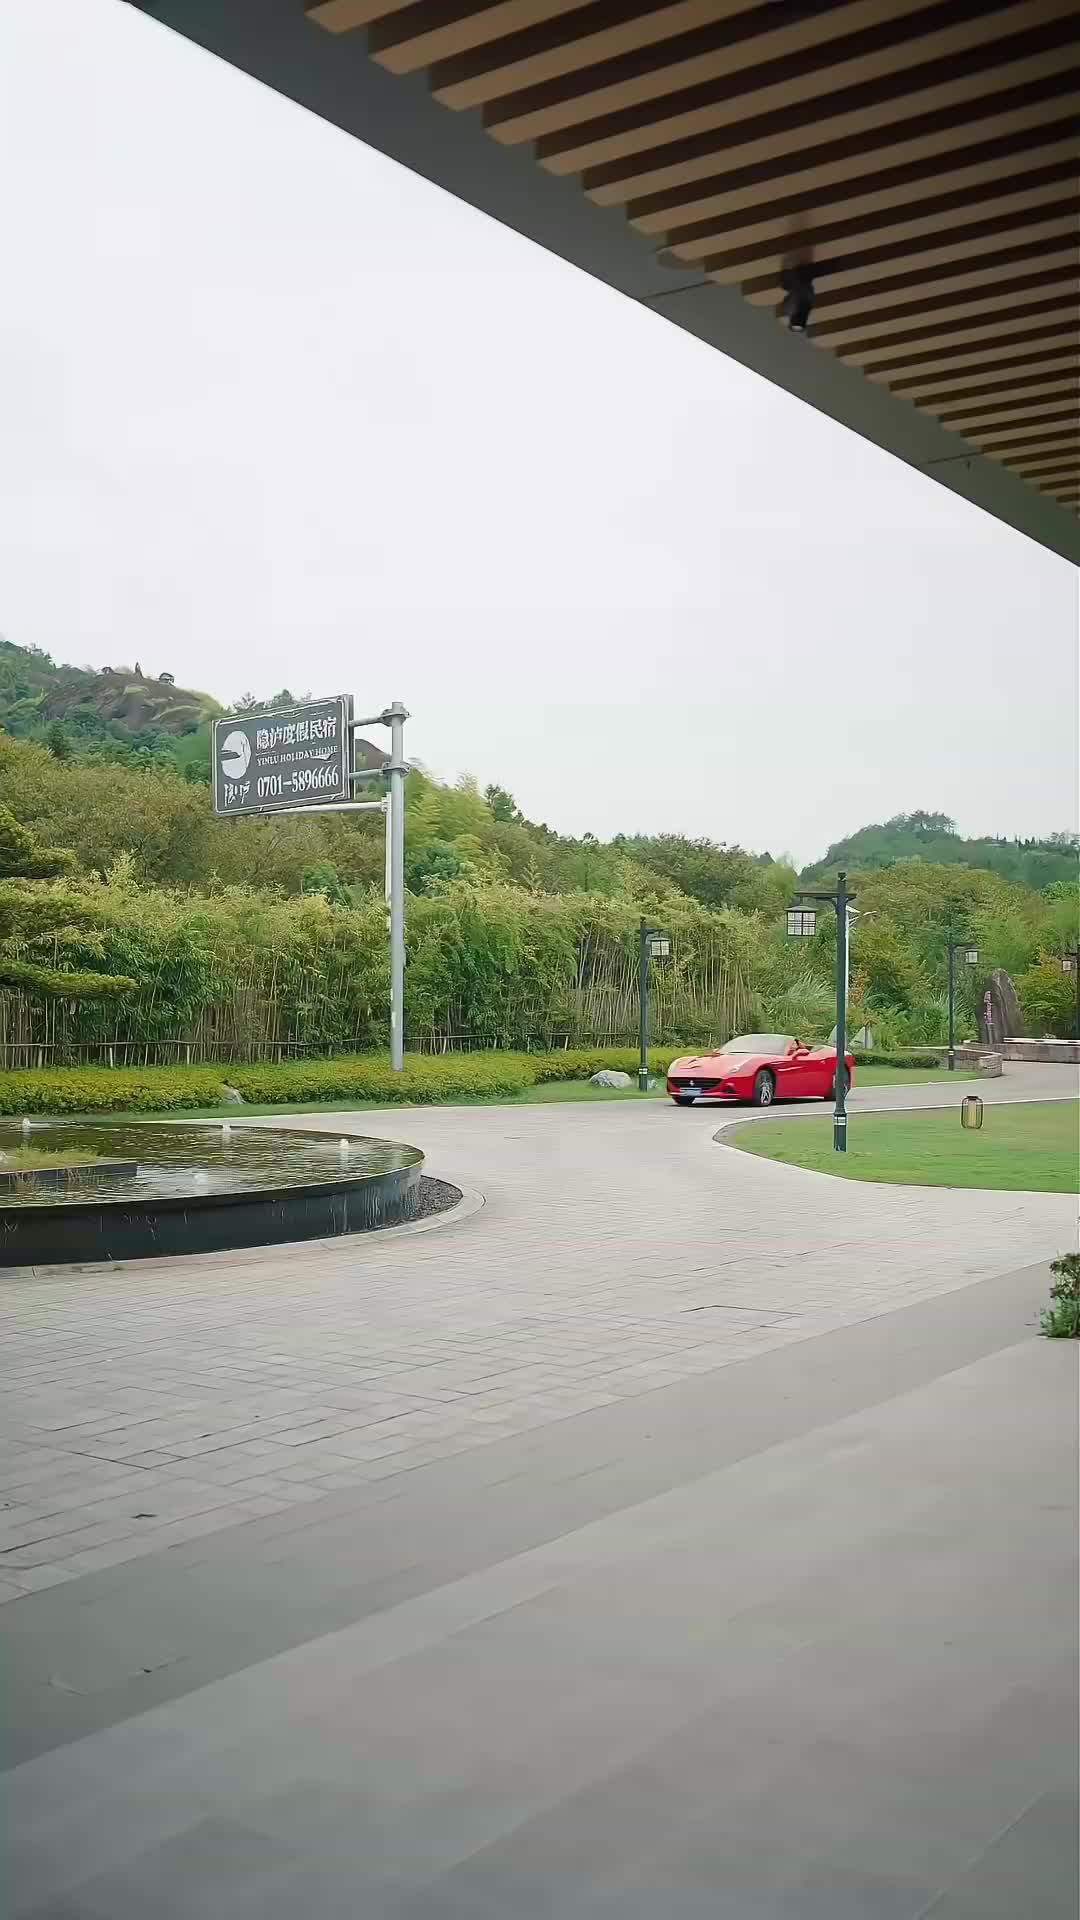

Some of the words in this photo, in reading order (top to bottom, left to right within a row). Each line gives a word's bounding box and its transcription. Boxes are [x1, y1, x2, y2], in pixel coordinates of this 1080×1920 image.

[280, 748, 314, 763] HOLIDAY
[315, 745, 339, 756] HOME
[257, 764, 339, 798] 0701-5896666
